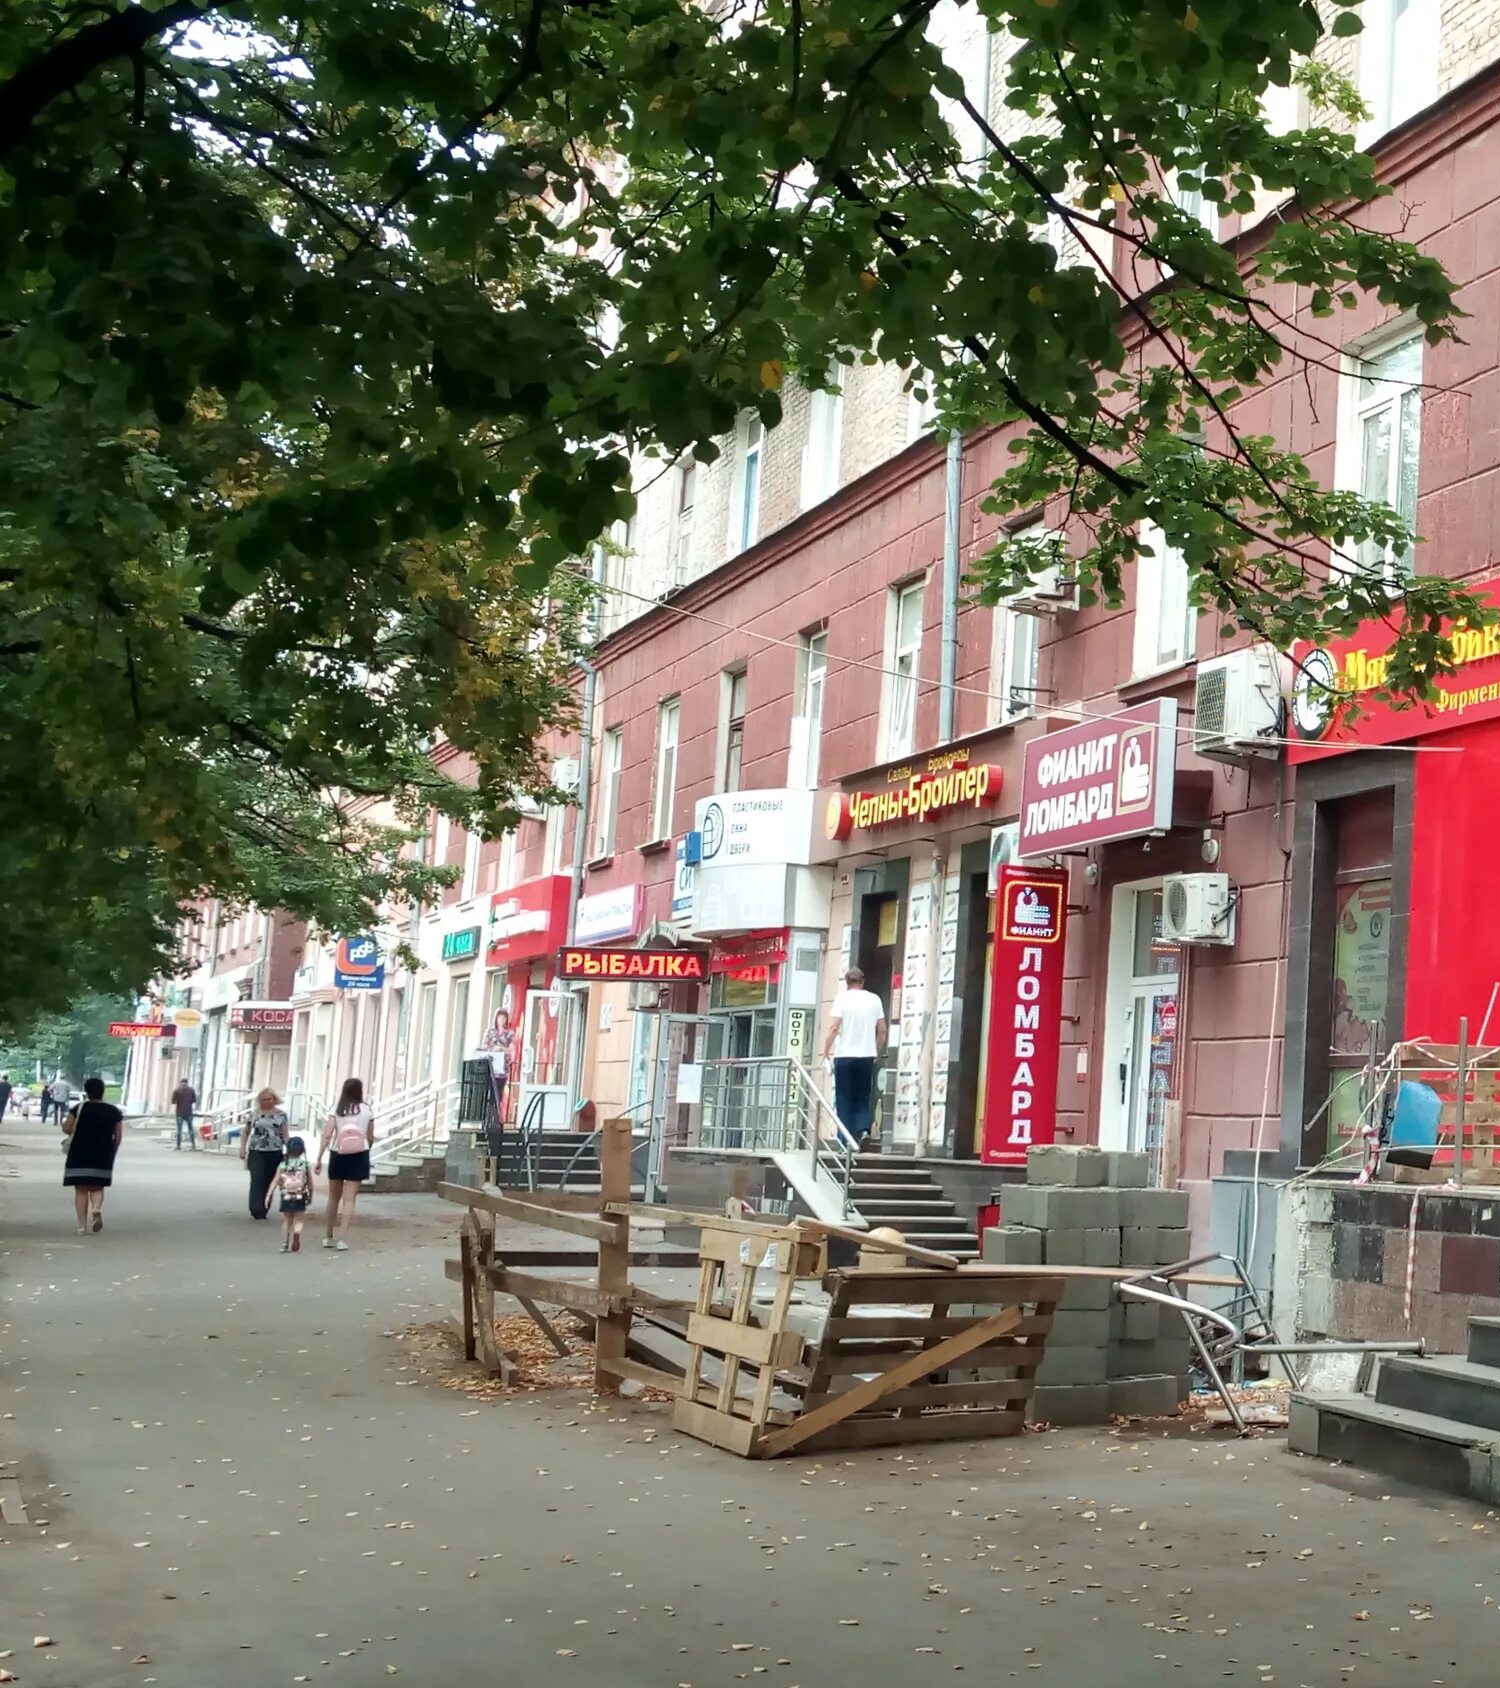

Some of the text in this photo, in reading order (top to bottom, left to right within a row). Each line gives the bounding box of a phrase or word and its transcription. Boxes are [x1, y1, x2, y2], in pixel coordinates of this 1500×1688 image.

[1037, 733, 1118, 788] ФИАНИТ
[732, 799, 784, 813] ПЛАСТИКОВЫЕ
[1023, 782, 1114, 838] ЛОМБАРД
[730, 823, 748, 835] ОКНА
[729, 843, 751, 855] ДВЕРИ
[1010, 926, 1054, 937] ФИАНИТ
[565, 952, 701, 977] РЫБАЛКА
[790, 1011, 803, 1047] ФОТО
[1007, 946, 1043, 1144] ЛОМБАРД
